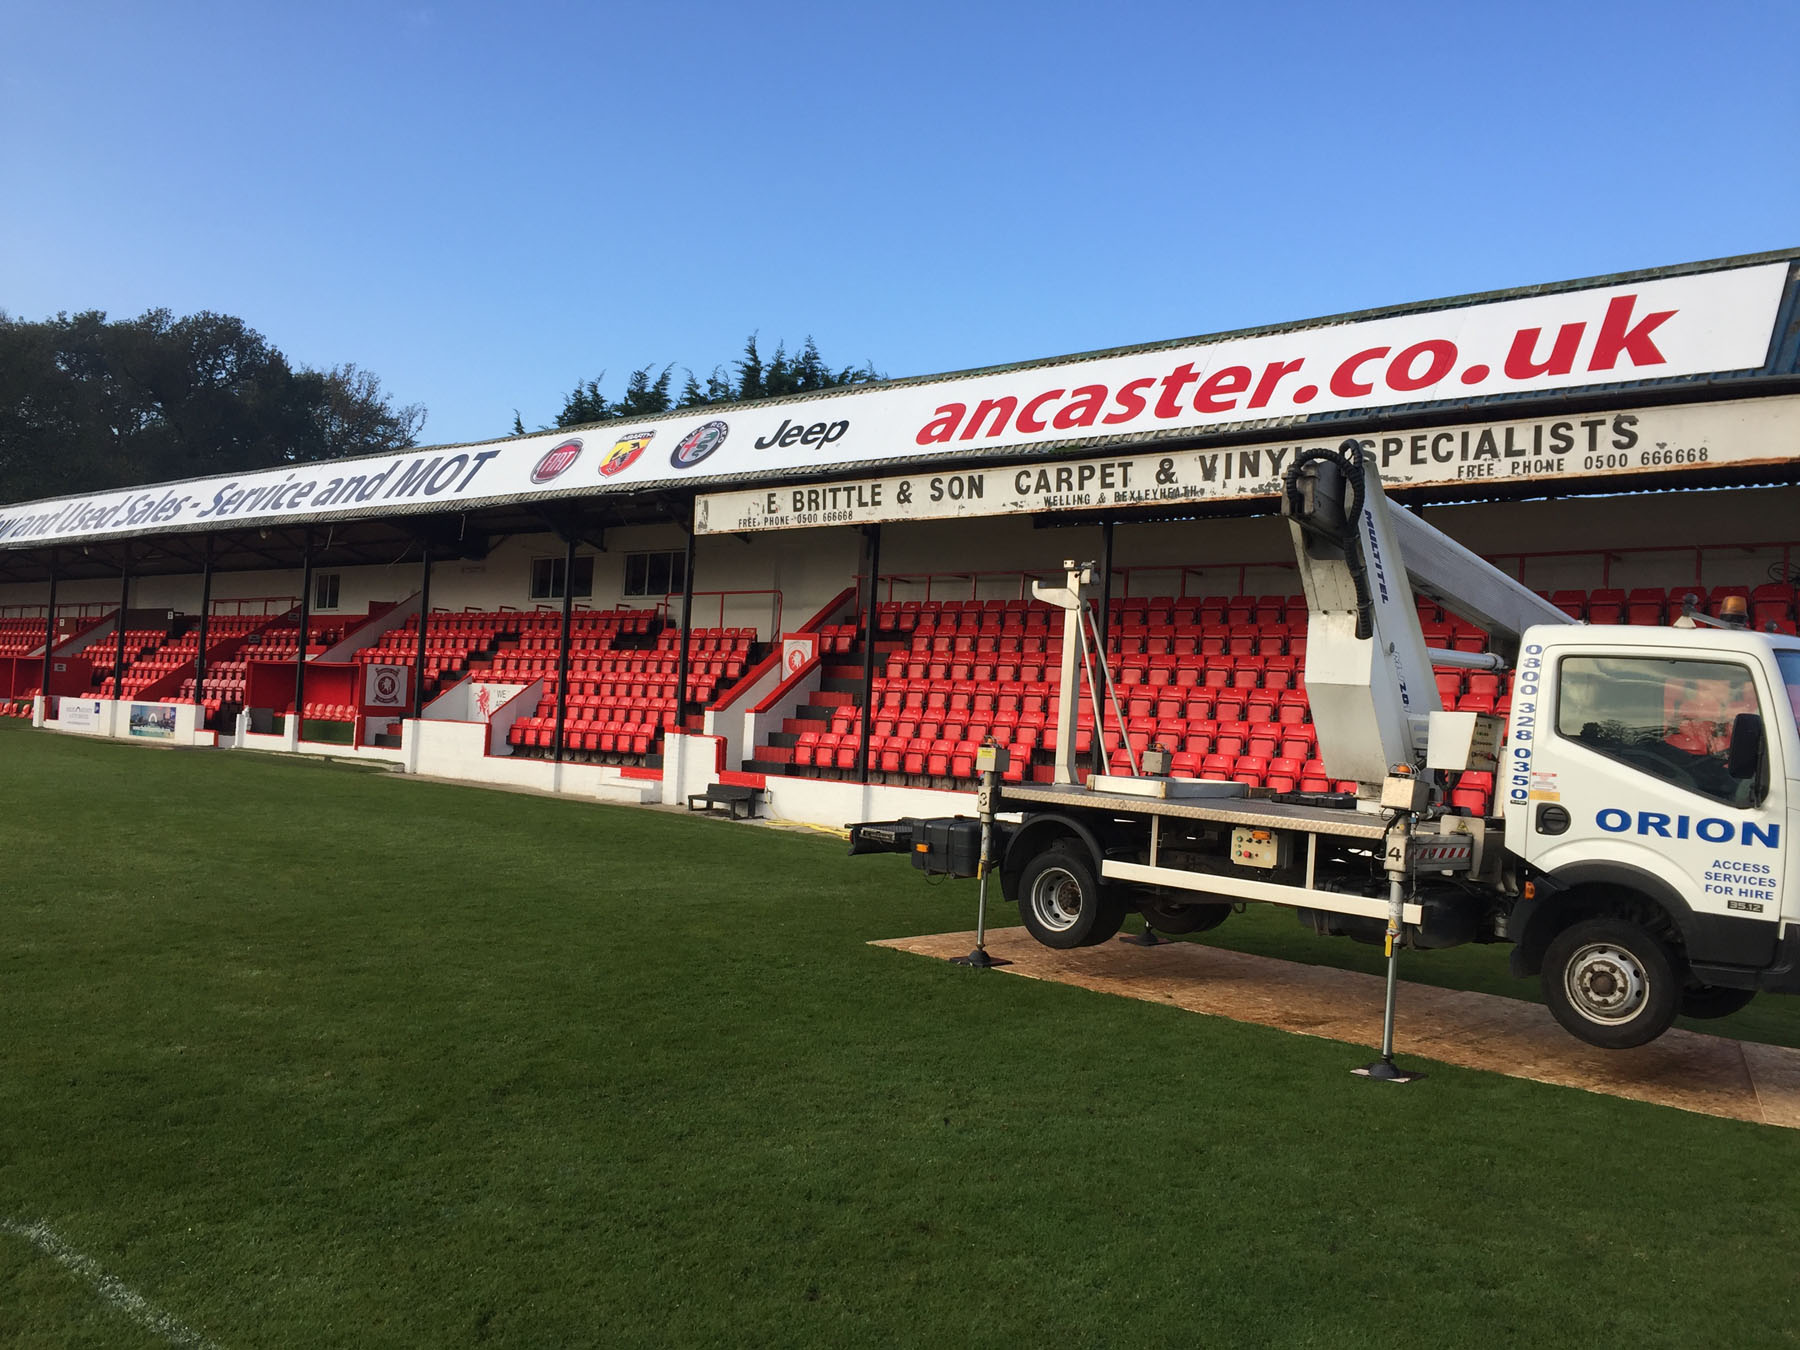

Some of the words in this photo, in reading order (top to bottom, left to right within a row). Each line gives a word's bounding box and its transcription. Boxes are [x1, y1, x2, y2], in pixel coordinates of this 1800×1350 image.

[915, 294, 1681, 446] ancaster.co.uk
[621, 431, 655, 442] ABARTH
[679, 425, 706, 447] ALFA
[710, 421, 729, 444] ROMEO
[754, 418, 850, 450] Jeep
[539, 450, 576, 473] FIAT
[793, 483, 882, 513] BRITTLE
[897, 480, 913, 504] &
[930, 474, 984, 501] SON
[1015, 461, 1133, 495] CARPET
[1155, 457, 1178, 485] &
[1360, 415, 1639, 467] SPECIALISTS
[1458, 462, 1494, 478] FREE
[1511, 459, 1565, 475] PHONE
[1584, 453, 1628, 470] 0500
[1640, 447, 1709, 466] 666668
[10, 503, 73, 537] and
[55, 495, 133, 532] Used
[112, 490, 192, 527] Sales
[196, 473, 317, 518] Service
[310, 460, 401, 506] and
[383, 450, 502, 499] MOT
[1044, 493, 1091, 507] WELLING
[1097, 492, 1106, 504] &
[1114, 485, 1197, 503] BEXLEYHEATH
[1364, 509, 1389, 604] MULTITEL
[1520, 644, 1543, 695] 0800
[1516, 702, 1536, 740] 328
[1510, 748, 1532, 799] 0350
[980, 792, 988, 807] 3
[1595, 808, 1780, 849] ORION
[1388, 846, 1401, 862] 4
[1712, 859, 1771, 874] ACCESS
[1704, 871, 1777, 887] SERVICES
[1705, 884, 1733, 896] FOR
[1738, 887, 1774, 900] HIRE
[1729, 901, 1762, 912] 35.12
